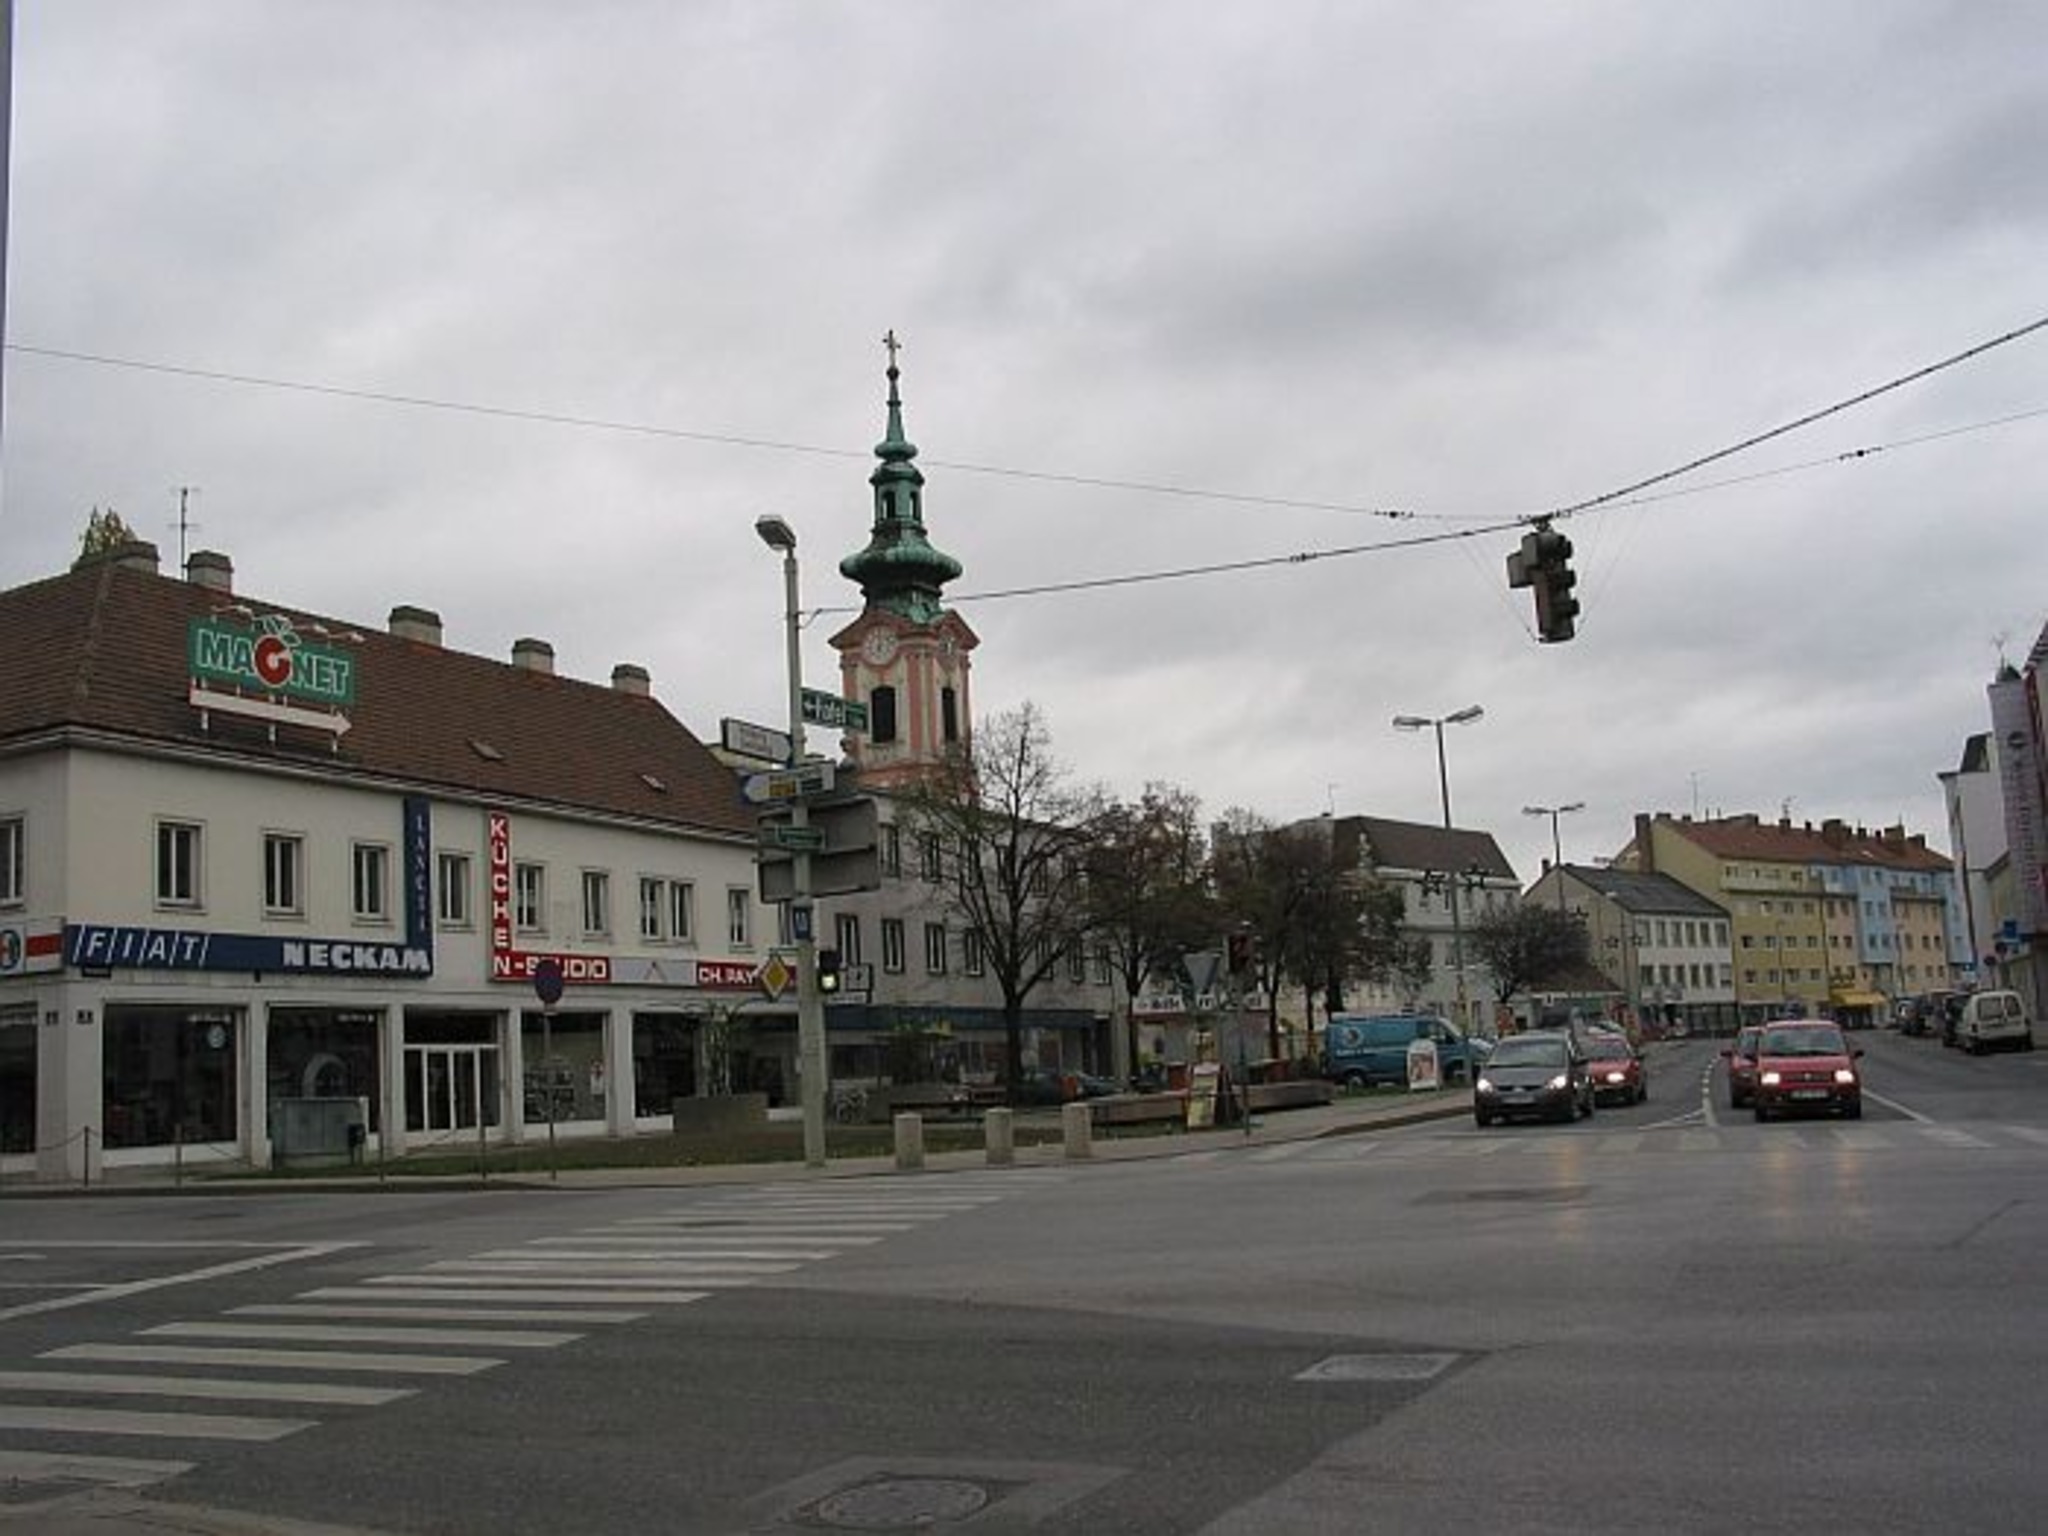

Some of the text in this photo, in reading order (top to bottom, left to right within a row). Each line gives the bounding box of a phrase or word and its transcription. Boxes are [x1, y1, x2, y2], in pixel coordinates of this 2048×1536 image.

[198, 628, 349, 695] MAGNET
[84, 929, 201, 962] FIAT
[283, 941, 431, 971] NECKAM
[493, 955, 607, 979] N-SUDIO
